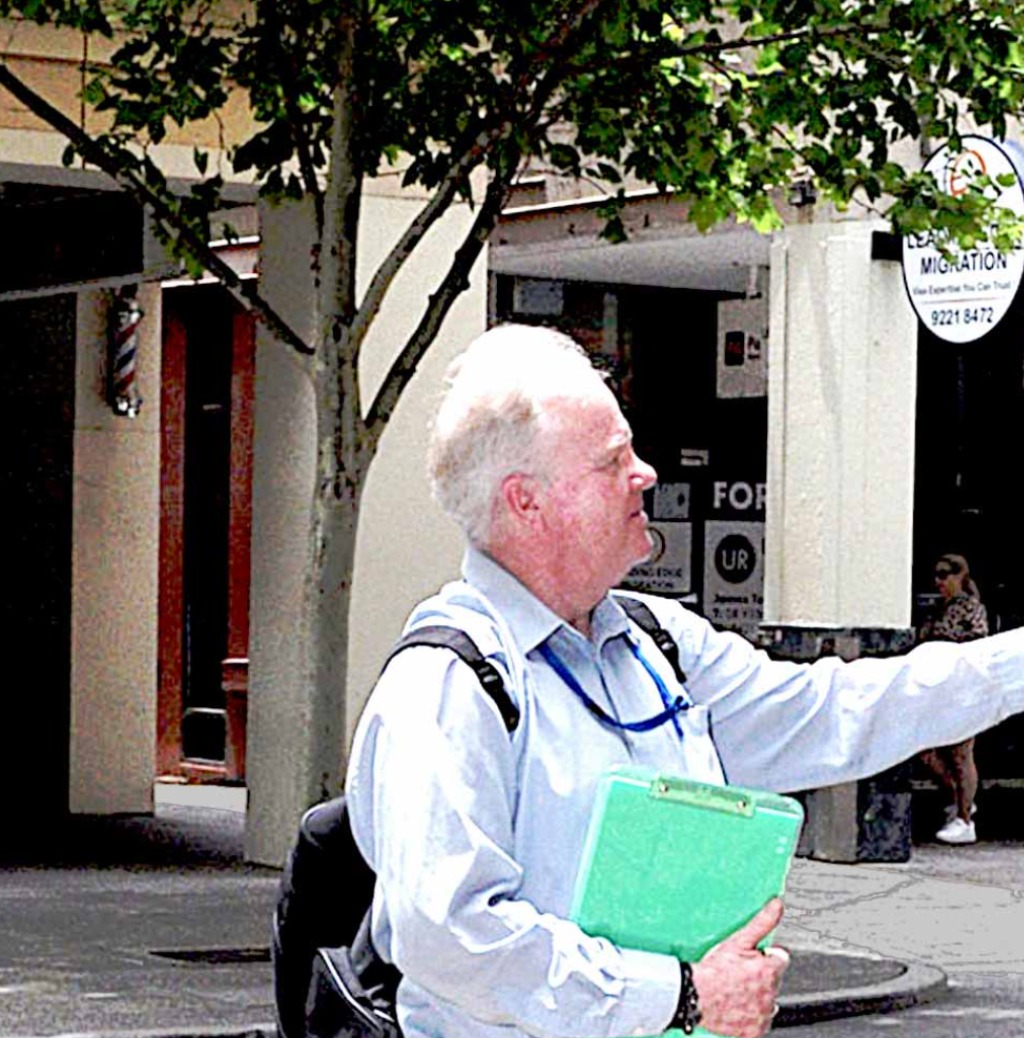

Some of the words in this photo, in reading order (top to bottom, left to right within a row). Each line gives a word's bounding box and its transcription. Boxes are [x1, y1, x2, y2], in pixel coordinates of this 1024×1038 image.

[931, 309, 960, 326] 9221
[963, 306, 994, 324] 8472
[722, 549, 749, 570] UR
